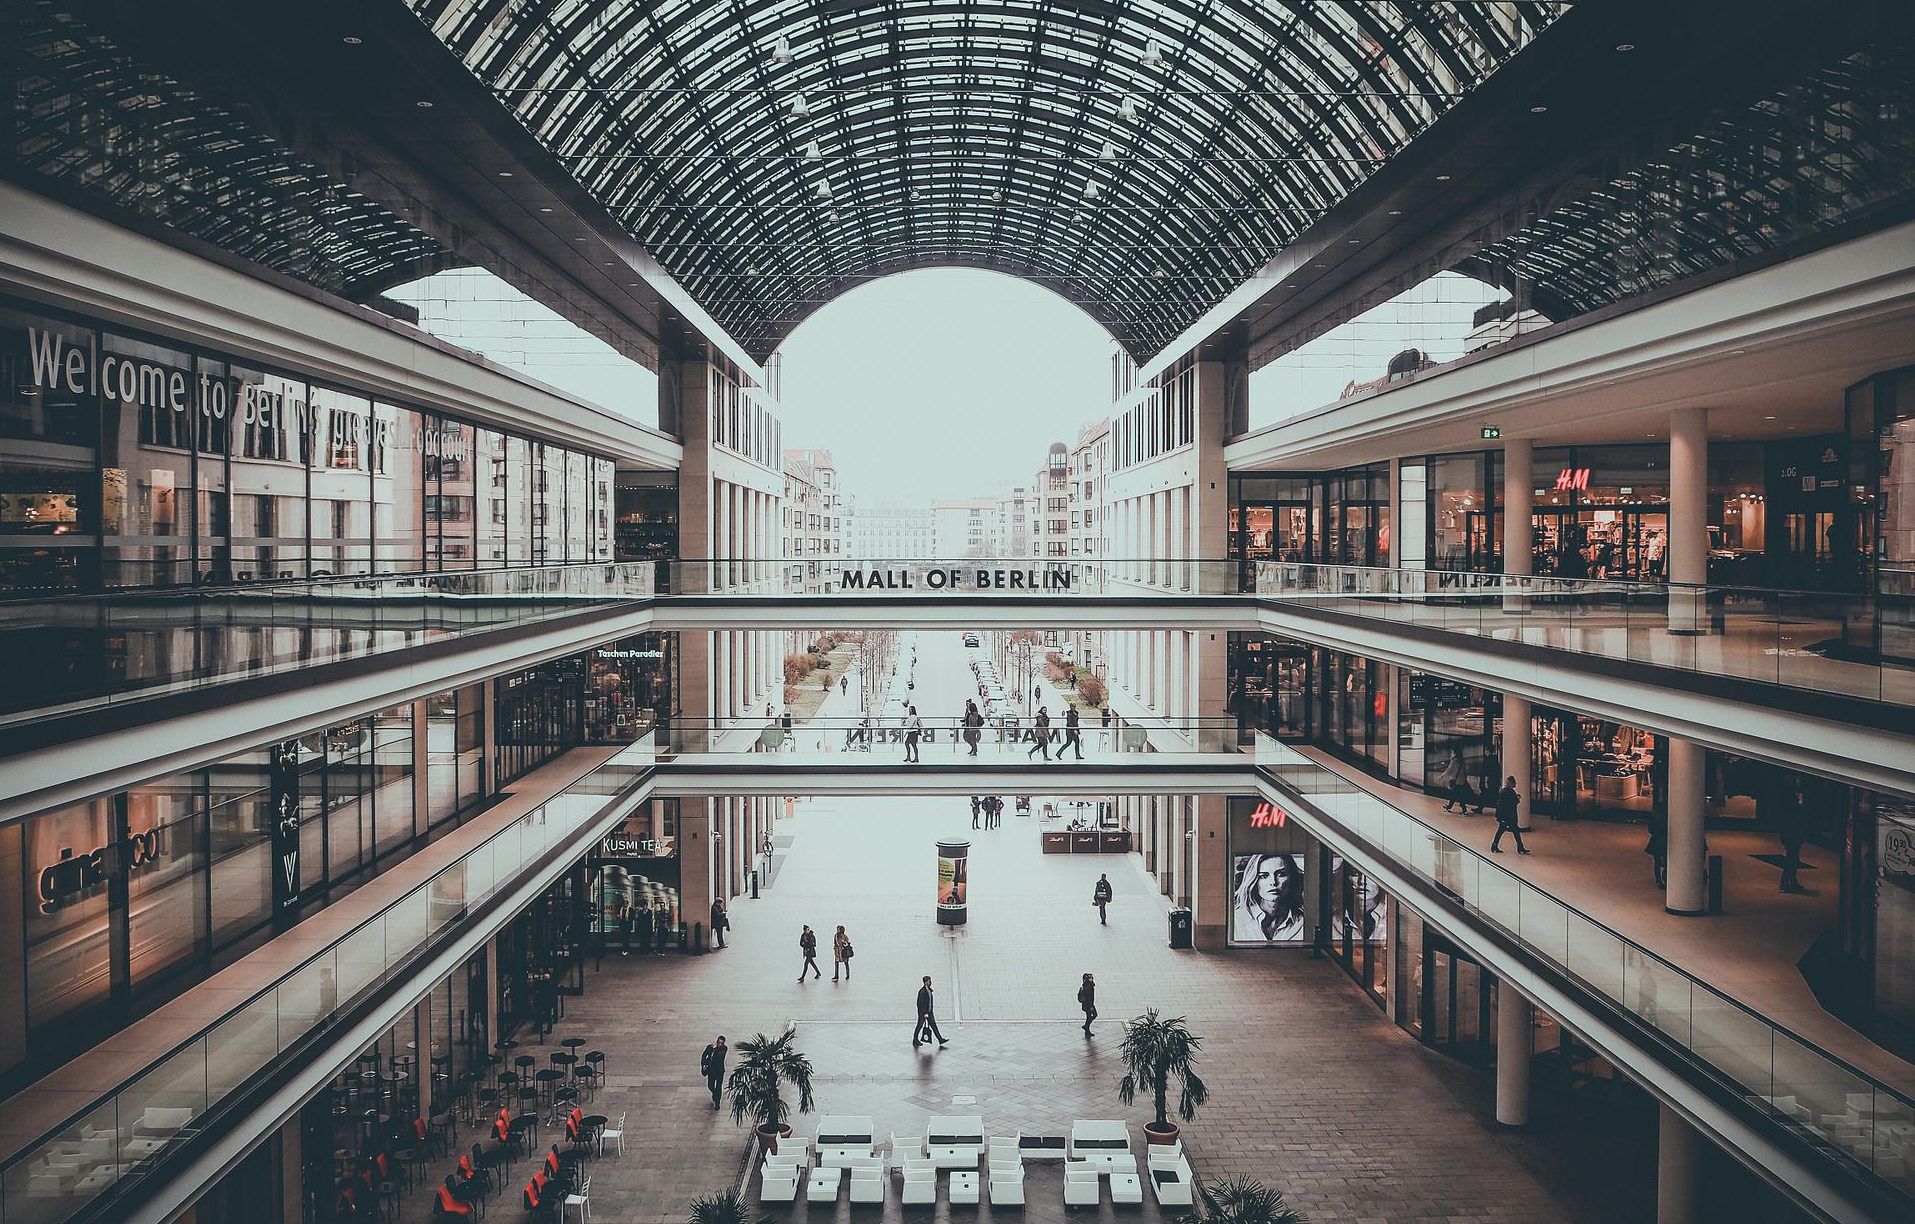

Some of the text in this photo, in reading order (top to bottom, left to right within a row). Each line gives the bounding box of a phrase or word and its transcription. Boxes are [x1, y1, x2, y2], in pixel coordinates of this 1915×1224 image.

[28, 327, 186, 412] Welcome
[201, 372, 226, 419] to
[334, 408, 399, 451] greates
[1556, 468, 1590, 490] H&M
[841, 569, 1072, 589] MALL OF BERLIN
[597, 649, 664, 658] Taschen Paradies
[1250, 802, 1286, 828] H&M
[603, 837, 664, 853] KUSMI TEA
